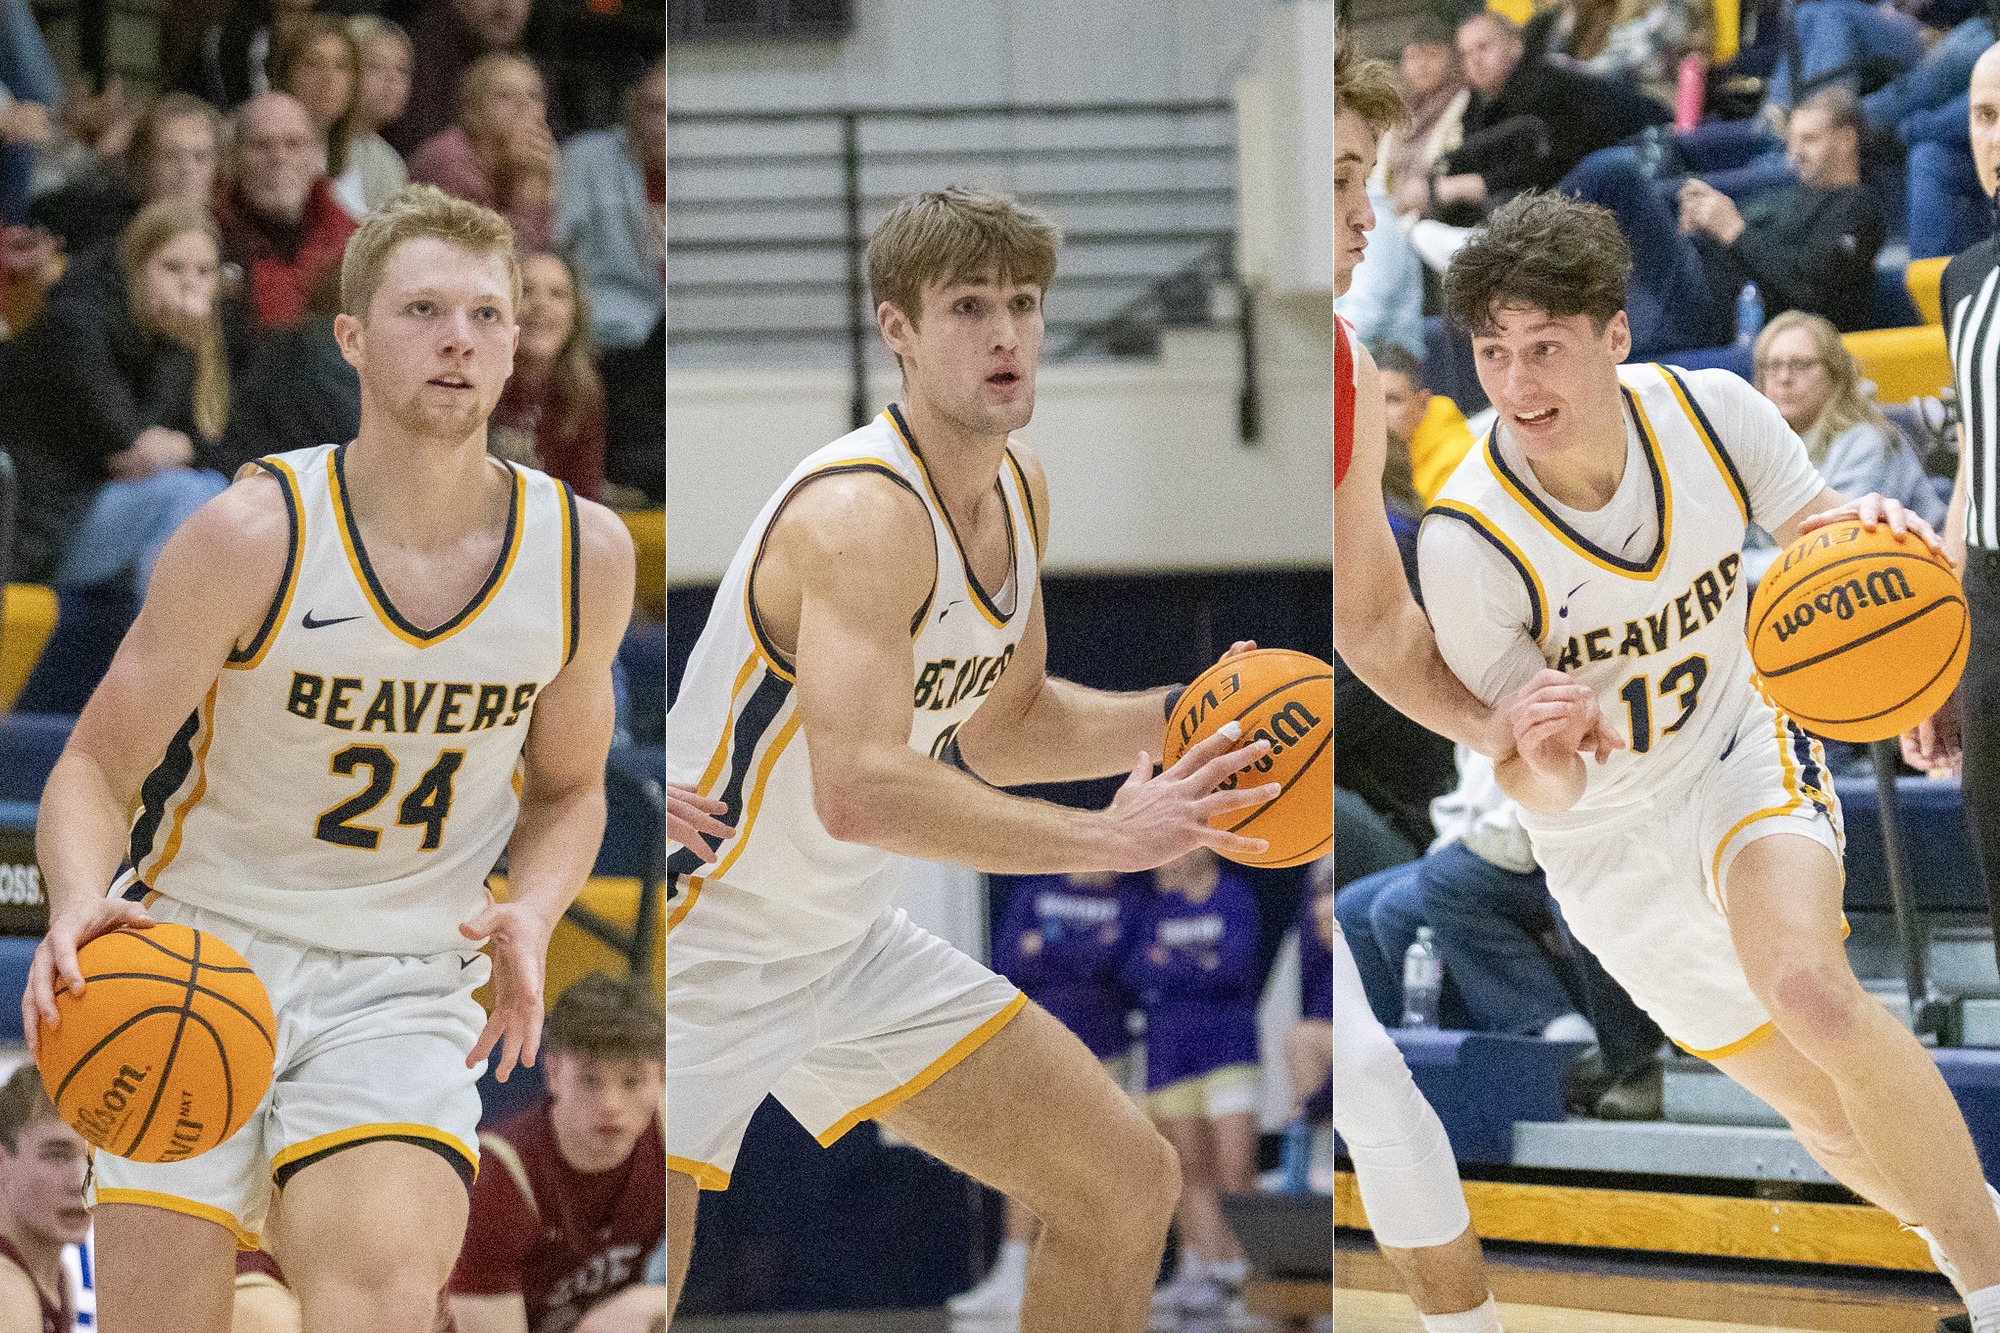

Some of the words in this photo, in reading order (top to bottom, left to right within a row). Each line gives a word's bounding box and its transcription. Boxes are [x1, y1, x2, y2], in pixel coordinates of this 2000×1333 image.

[1772, 566, 1916, 642] Wilson
[286, 670, 538, 734] BEAVERS
[1180, 672, 1241, 745] EVO
[1619, 653, 1710, 755] 13
[314, 743, 467, 852] 24
